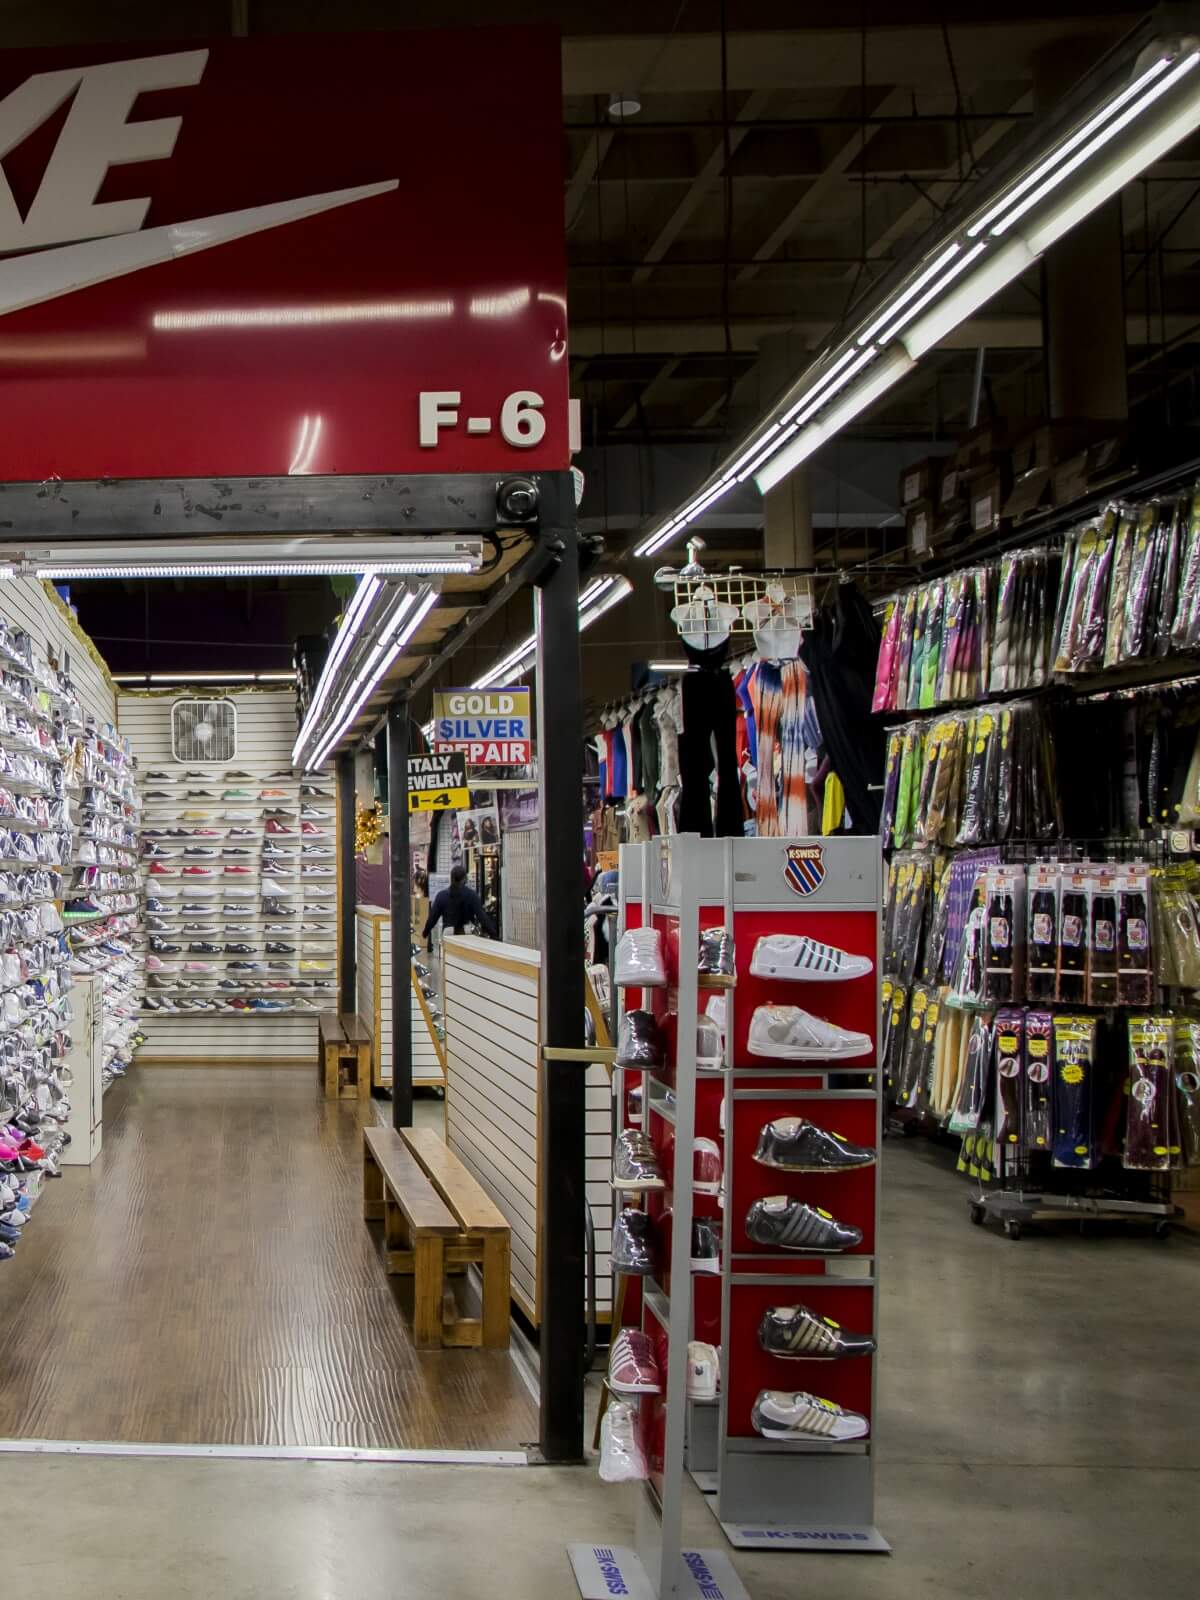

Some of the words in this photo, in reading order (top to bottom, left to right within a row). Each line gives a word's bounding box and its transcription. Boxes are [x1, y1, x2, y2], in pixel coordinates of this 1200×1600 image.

[419, 390, 546, 448] F-6
[449, 695, 514, 715] GOLD
[439, 719, 525, 739] SILVER
[407, 755, 451, 774] ITALY
[407, 771, 463, 790] EWELRY
